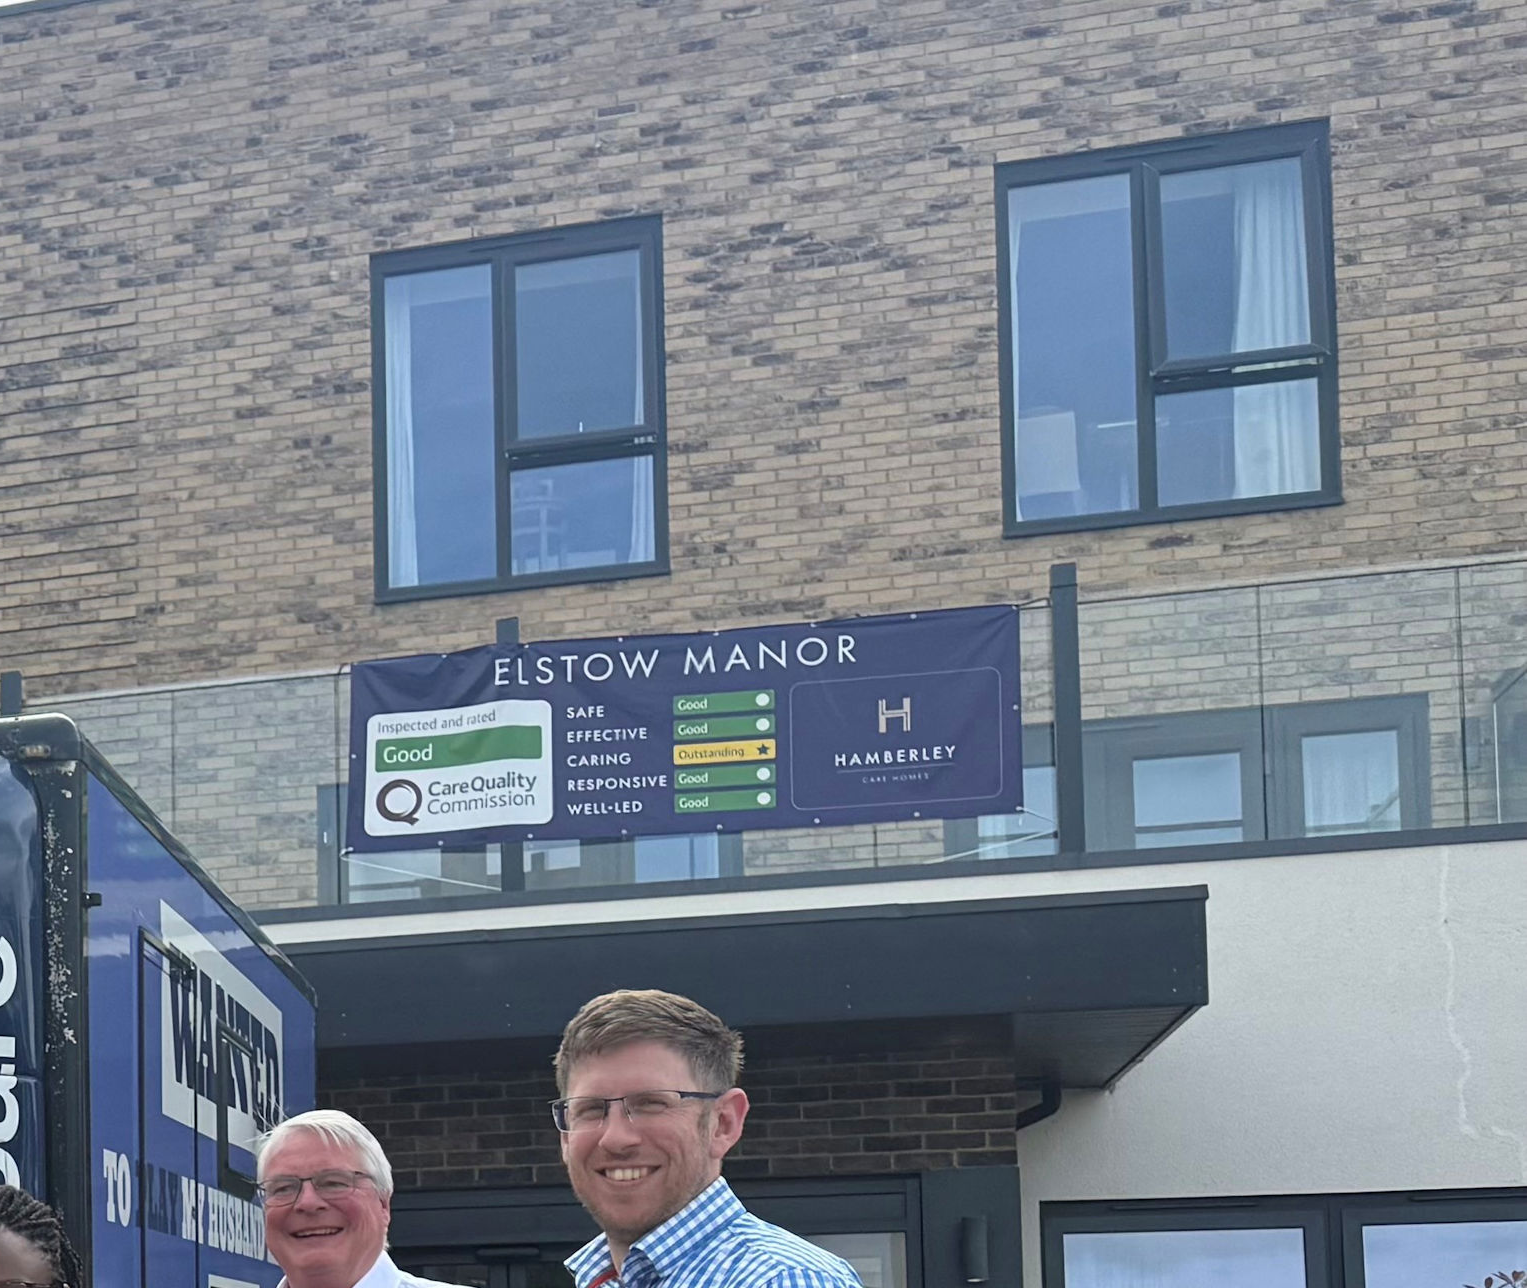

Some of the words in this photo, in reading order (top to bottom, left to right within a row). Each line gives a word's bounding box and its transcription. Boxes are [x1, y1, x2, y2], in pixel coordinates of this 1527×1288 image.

[494, 649, 659, 686] ELSTOW
[683, 634, 857, 676] MANOR
[566, 705, 605, 719] SAFE
[677, 698, 708, 711] Good
[378, 717, 437, 735] Inspected
[441, 714, 463, 729] and
[466, 708, 497, 726] rated
[677, 723, 708, 736] Good
[567, 727, 648, 743] EFFECTIVE
[383, 743, 433, 764] Good
[567, 752, 632, 767] CARING
[678, 746, 745, 761] Outstanding
[834, 745, 956, 767] HAMBERLEY
[568, 774, 668, 792] RESPONSIVE
[678, 772, 709, 785] Good
[427, 790, 536, 815] Commission
[568, 800, 643, 816] WELL-LED
[678, 796, 709, 810] Good
[103, 1148, 132, 1228] TO
